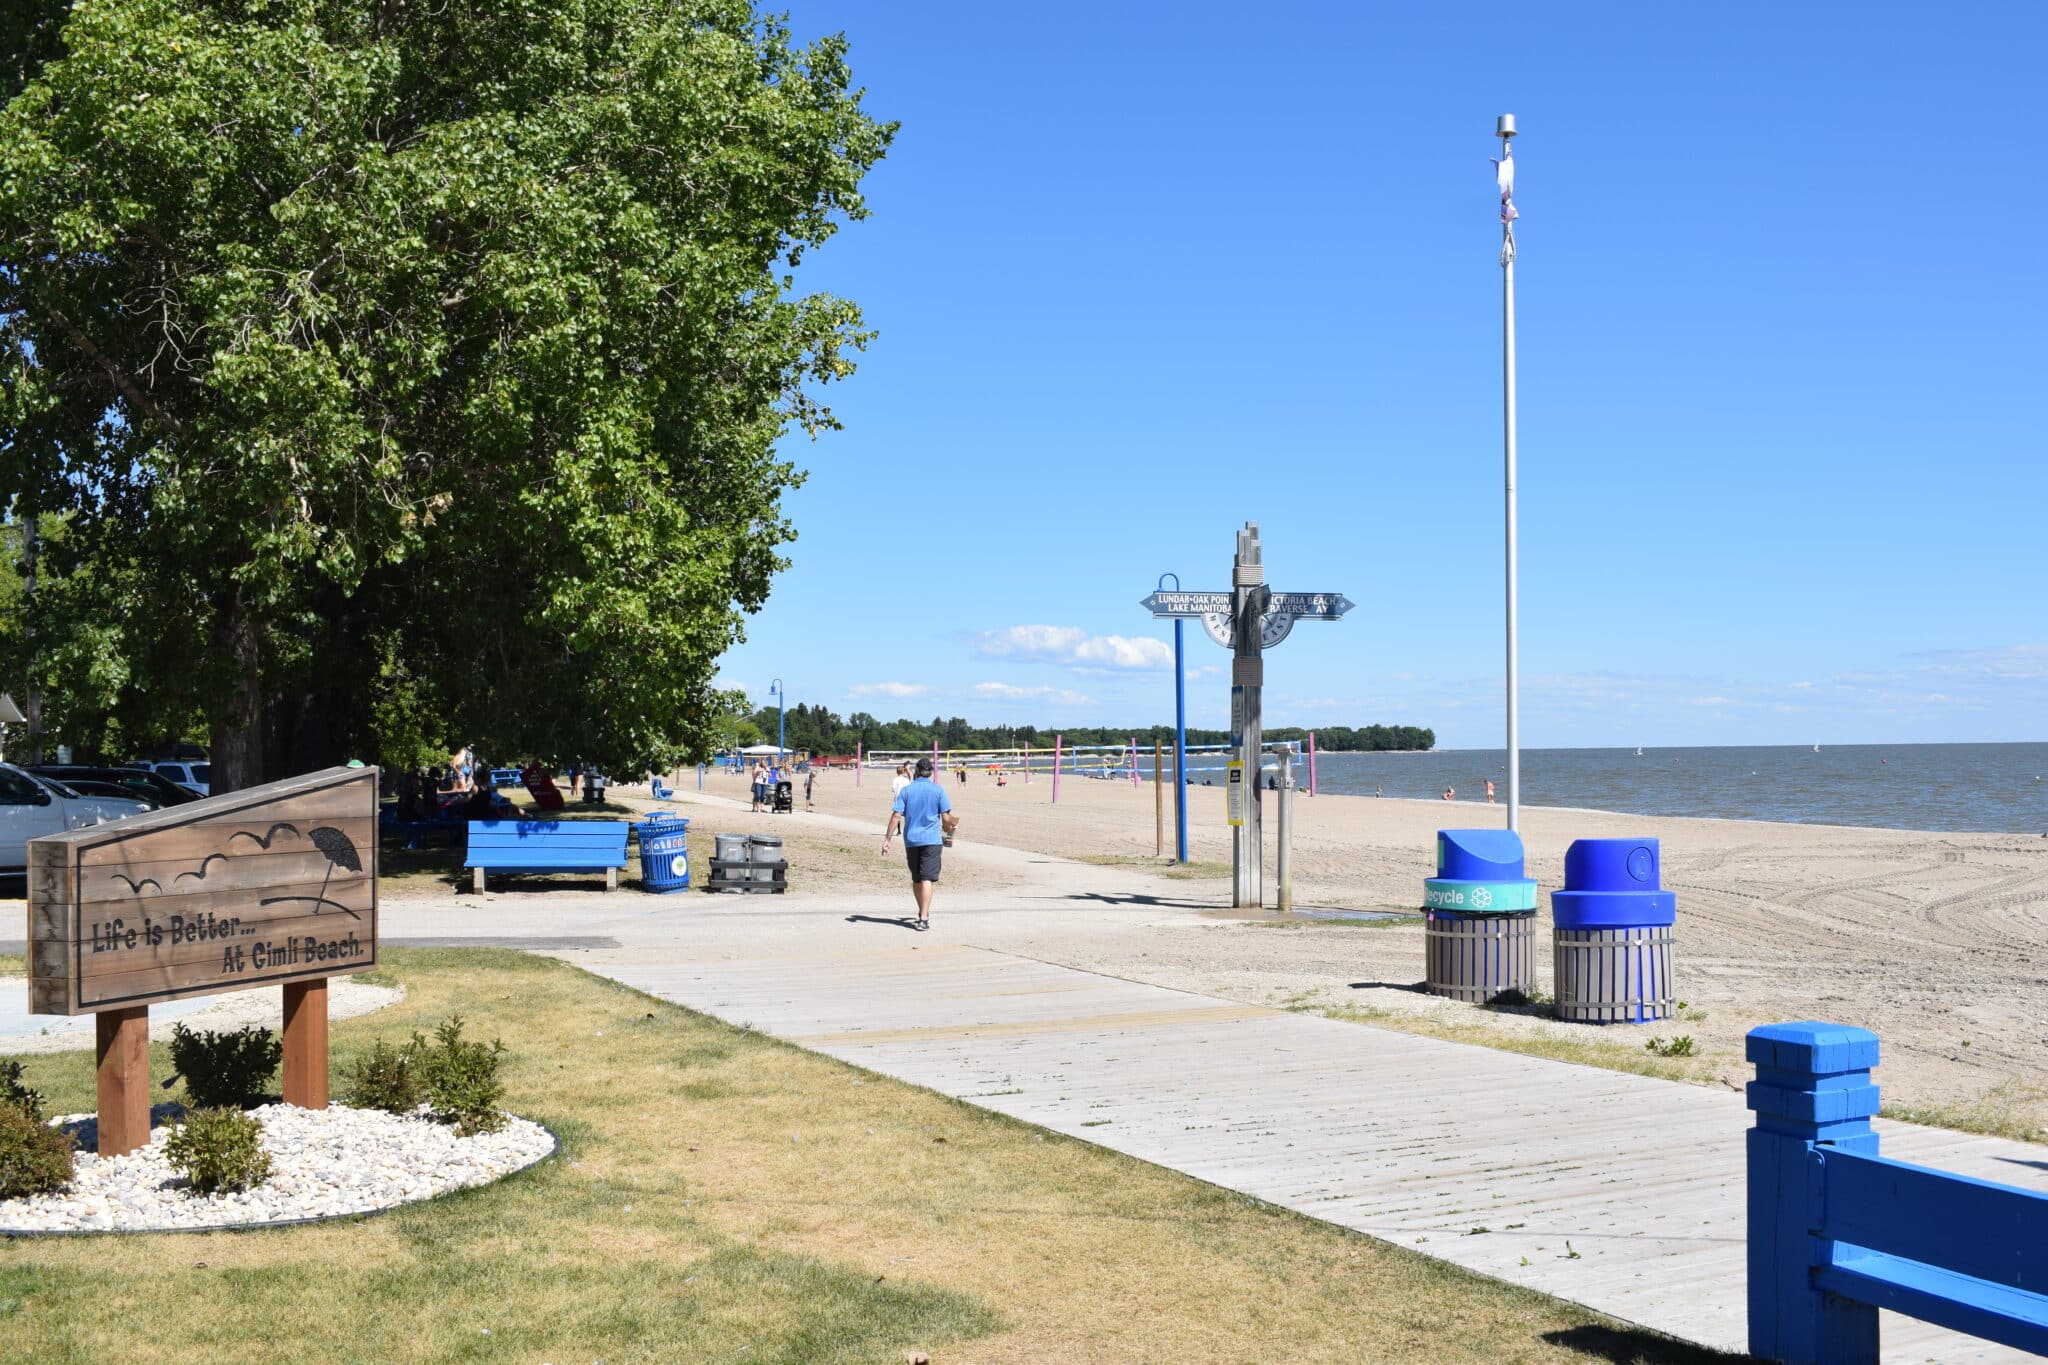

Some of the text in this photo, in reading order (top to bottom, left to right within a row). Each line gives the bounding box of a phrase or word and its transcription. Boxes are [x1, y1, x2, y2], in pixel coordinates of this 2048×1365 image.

[1210, 596, 1232, 605] POIN
[1270, 596, 1336, 606] ICTORIA BEACH
[1168, 604, 1232, 613] LAKE MANITOBA
[1268, 605, 1309, 614] RAVERSE
[92, 911, 256, 953] Life is Better...
[222, 931, 364, 974] At Gimli Beach.
